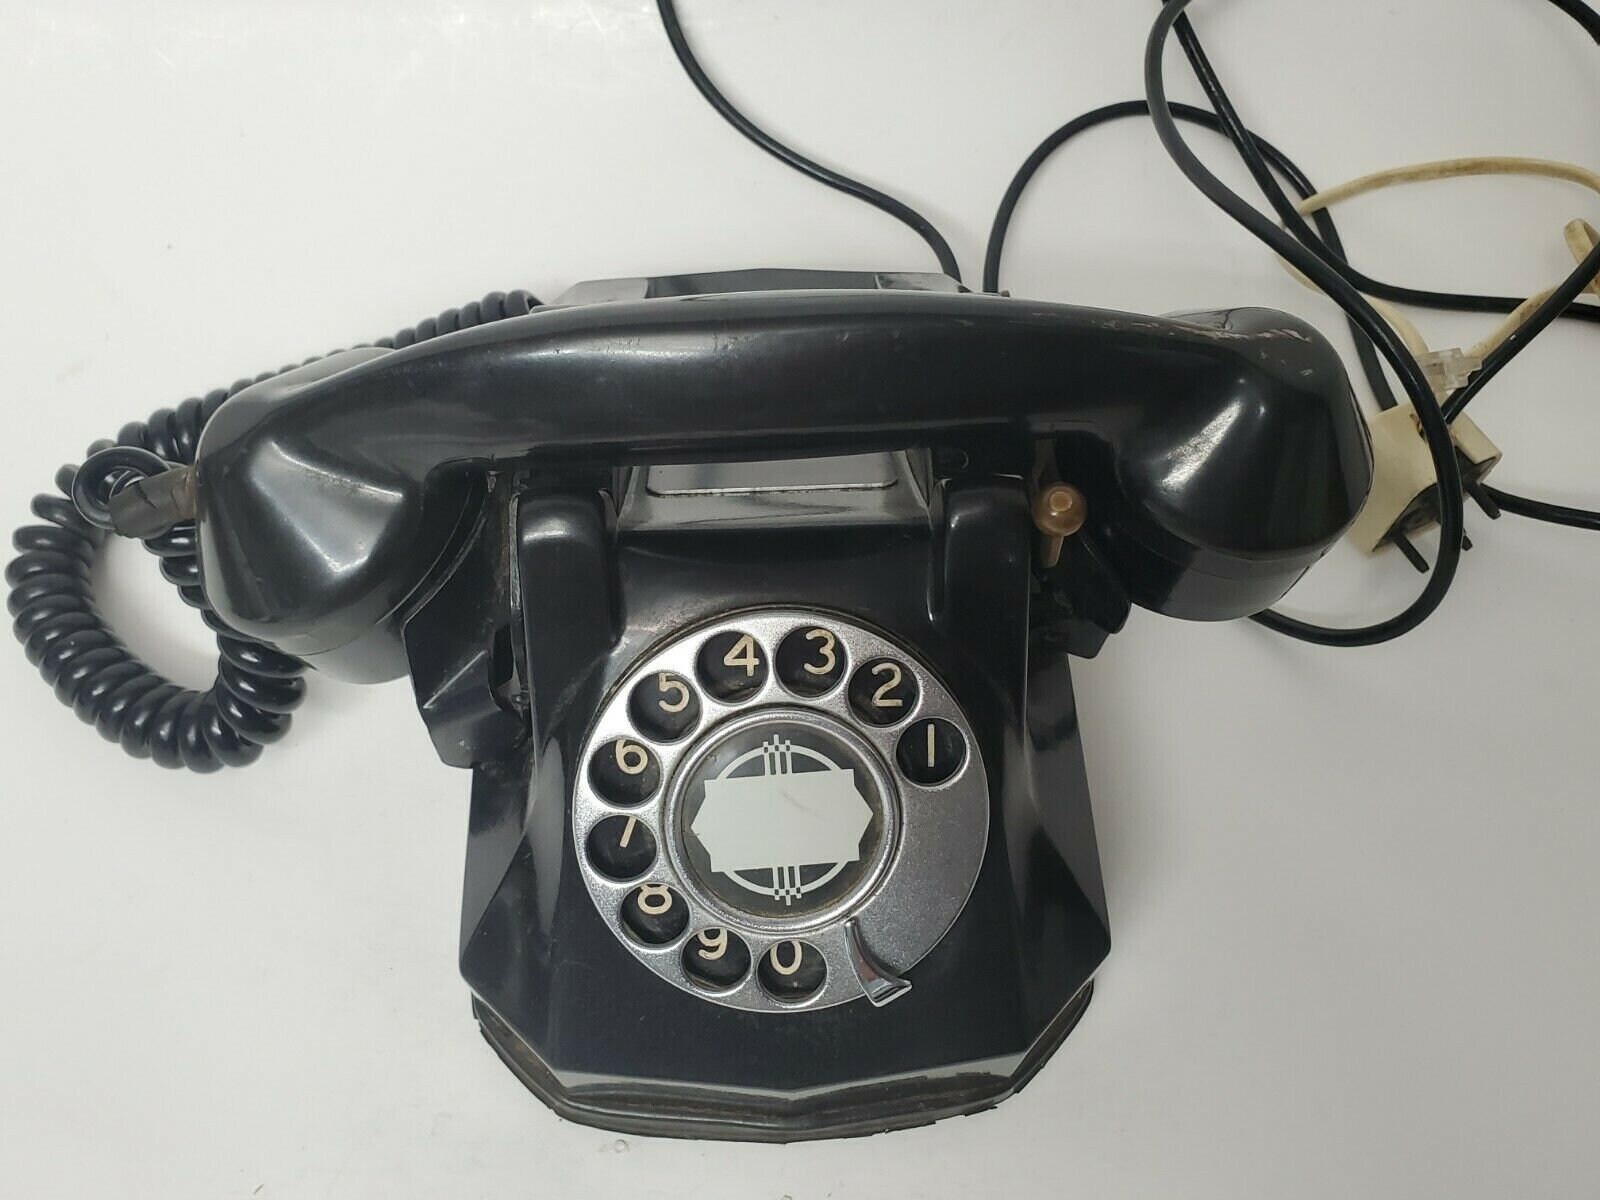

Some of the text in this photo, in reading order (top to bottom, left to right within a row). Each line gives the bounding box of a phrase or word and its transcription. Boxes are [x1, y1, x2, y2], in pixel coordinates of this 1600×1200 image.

[723, 634, 760, 676] 4
[803, 629, 836, 675] 3
[658, 672, 690, 713] 5
[871, 662, 903, 707] 2
[615, 739, 649, 775] 6
[927, 723, 935, 768] 1
[637, 884, 673, 915] 8
[698, 929, 728, 961] 9
